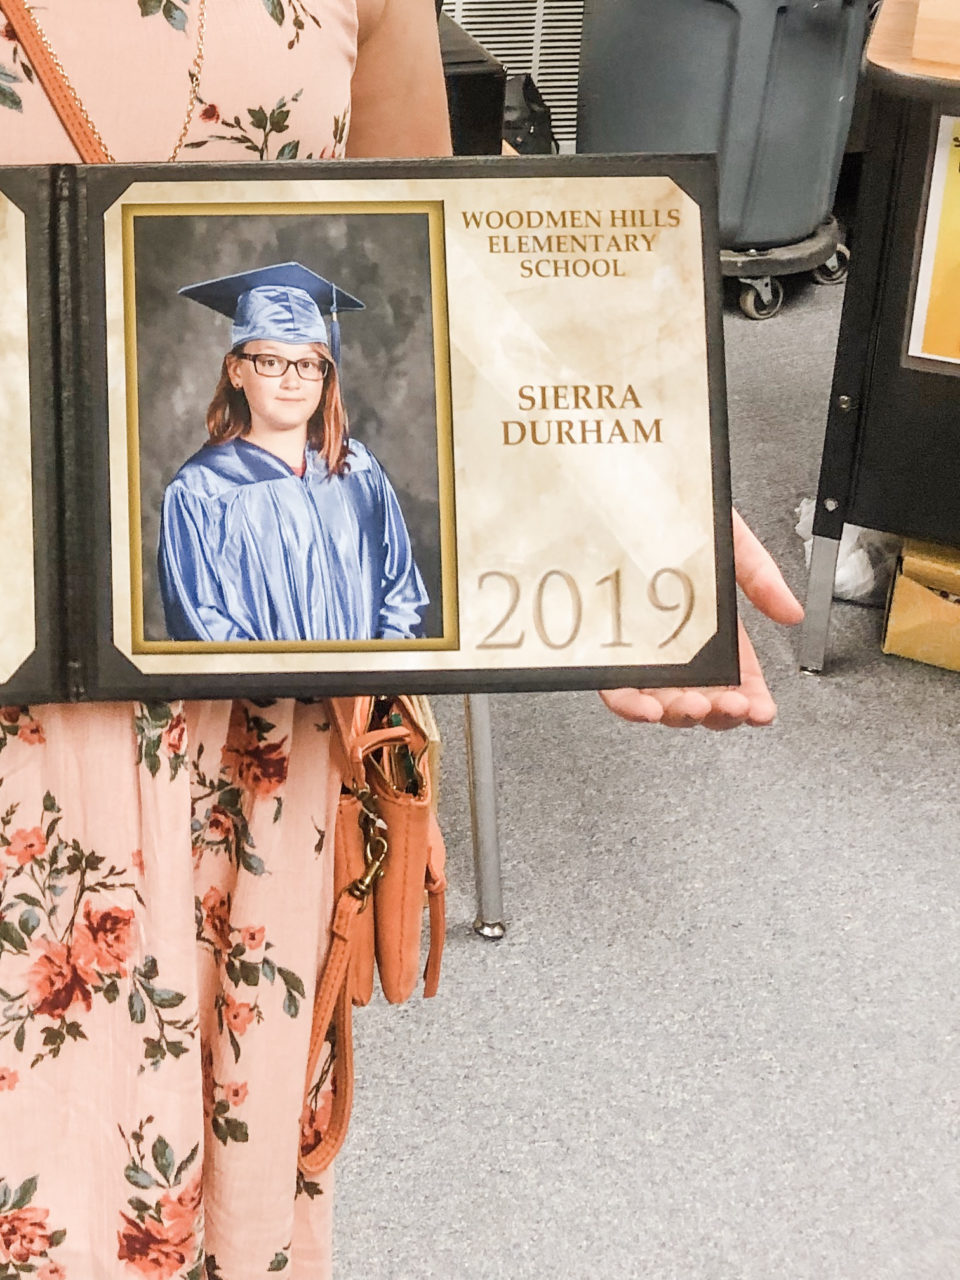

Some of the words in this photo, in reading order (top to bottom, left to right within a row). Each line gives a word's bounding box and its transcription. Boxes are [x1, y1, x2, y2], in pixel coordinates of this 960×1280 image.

[462, 210, 602, 229] WOODMEN
[609, 208, 681, 228] HILLS
[488, 233, 657, 254] ELEMENTARY
[520, 258, 626, 278] SCHOOL
[518, 384, 642, 411] SIERRA
[502, 418, 664, 447] DURHAM
[475, 567, 697, 651] 2019
